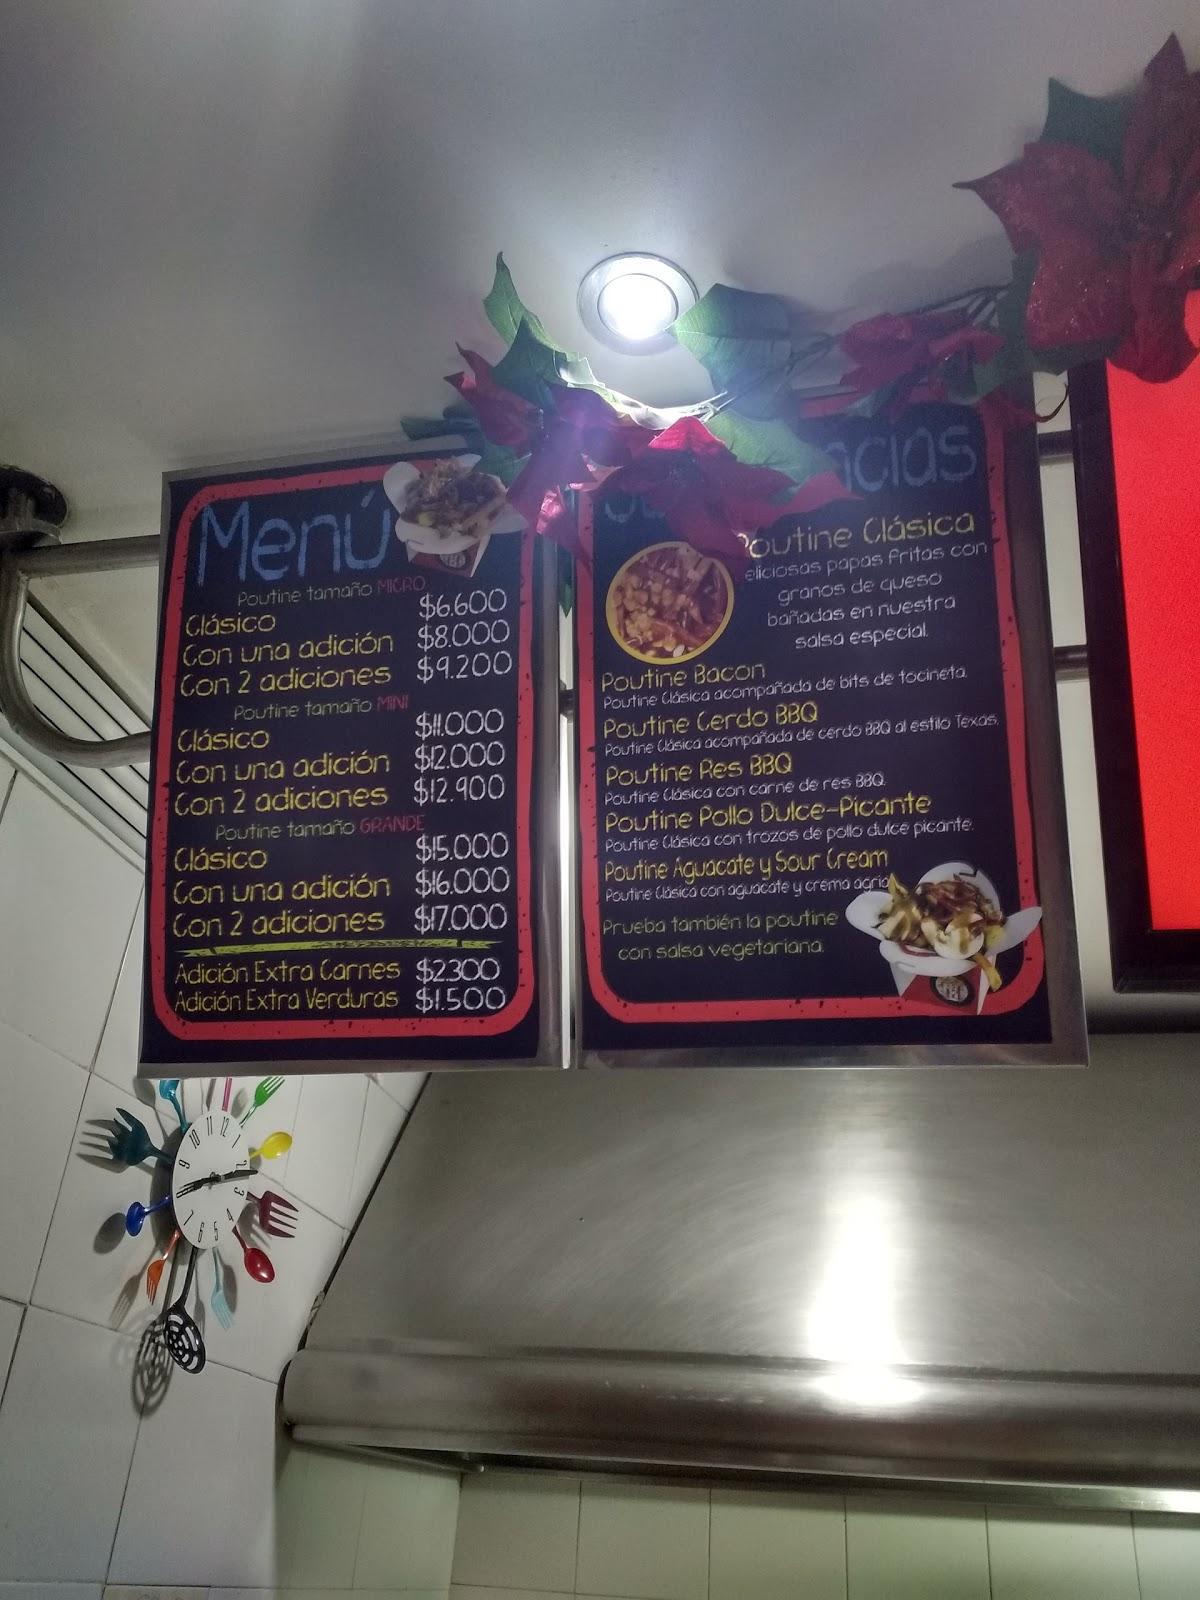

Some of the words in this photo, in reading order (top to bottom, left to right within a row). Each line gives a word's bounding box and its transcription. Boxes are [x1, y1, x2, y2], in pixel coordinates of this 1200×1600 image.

[197, 490, 392, 586] Menú
[863, 512, 975, 544] Clásica
[827, 554, 883, 576] papas
[888, 545, 944, 565] fritas
[951, 541, 987, 557] con
[238, 589, 301, 607] Poutine
[307, 582, 372, 601] tamaño
[377, 577, 426, 594] MICRO
[778, 583, 845, 606] granos
[851, 578, 875, 594] de
[880, 573, 942, 595] queso
[186, 612, 276, 637] Clásico
[419, 589, 507, 621] $6.600
[768, 606, 844, 627] bañadas
[850, 606, 873, 620] en
[878, 595, 956, 615] nuestra
[183, 644, 232, 667] Con
[241, 643, 290, 663] una
[299, 631, 394, 659] adición
[417, 619, 510, 651] $8.000
[795, 631, 844, 649] salsa
[850, 622, 928, 647] especial.
[181, 674, 229, 697] Con
[238, 670, 250, 694] 2
[260, 666, 392, 692] adiciones
[416, 651, 512, 684] $9.200
[601, 669, 687, 692] Poutine
[694, 664, 765, 684] Bacon
[603, 693, 657, 709] Poutine
[661, 690, 710, 705] Clásica
[714, 680, 811, 700] acompañada
[816, 678, 836, 692] de
[840, 673, 869, 689] bits
[873, 672, 894, 686] de
[234, 704, 300, 721] Poutine
[305, 699, 372, 716] tamaño
[376, 696, 409, 712] MINI
[603, 714, 690, 739] Poutine
[697, 706, 768, 732] Cerdo
[776, 701, 818, 726] BBQ
[178, 728, 269, 753] Clásico
[415, 709, 504, 740] $11.000
[605, 742, 654, 757] Poutine
[657, 738, 700, 752] Clásica
[705, 730, 793, 749] acompañada
[796, 728, 814, 742] de
[818, 724, 862, 740] cerdo
[865, 719, 891, 736] BBQ
[895, 720, 907, 733] al
[910, 715, 951, 732] estilo
[176, 761, 226, 785] Con
[234, 759, 284, 781] una
[293, 750, 390, 778] adición
[414, 741, 505, 773] $12.000
[606, 763, 693, 786] Poutine
[700, 759, 743, 780] Res
[750, 752, 792, 776] BBQ
[175, 792, 225, 817] Con
[233, 789, 245, 813] 2
[255, 786, 388, 813] adiciones
[414, 774, 505, 806] $12.900
[604, 790, 659, 805] Poutine
[663, 787, 712, 801] Clásica
[716, 786, 745, 798] con
[749, 782, 795, 796] carne
[799, 777, 818, 792] de
[823, 777, 851, 790] res
[605, 809, 693, 833] Poutine
[700, 804, 753, 827] Pollo
[761, 790, 931, 823] Dulce-Picante
[216, 824, 282, 841] Poutine
[287, 820, 355, 838] tamaño
[360, 815, 425, 832] GRANDE
[605, 837, 659, 852] Poutine
[662, 834, 710, 849] Clásica
[714, 833, 743, 846] con
[746, 829, 798, 843] trozos
[803, 826, 822, 840] de
[827, 823, 863, 843] pollo
[867, 821, 909, 837] dulce
[174, 847, 268, 871] Clásico
[416, 832, 508, 864] $15.000
[605, 859, 668, 881] Poutine
[673, 852, 755, 885] Aguacate
[759, 857, 772, 880] y
[776, 850, 820, 872] Sour
[826, 848, 888, 869] Cream
[173, 881, 223, 905] Con
[233, 879, 282, 902] una
[291, 873, 391, 899] adición
[415, 866, 509, 898] $16.000
[606, 887, 652, 902] Poutine
[655, 885, 697, 899] Clásica
[700, 885, 725, 897] con
[728, 880, 790, 900] aguacate
[793, 883, 802, 897] y
[805, 878, 850, 892] crema
[173, 913, 222, 938] Con
[231, 911, 242, 936] 2
[252, 909, 385, 936] adiciones
[414, 903, 507, 935] $17.000
[603, 918, 666, 935] Prueba
[671, 913, 741, 932] también
[746, 913, 761, 929] la
[766, 910, 839, 933] poutine
[618, 948, 651, 960] con
[656, 943, 703, 958] salsa
[708, 938, 824, 961] vegetariana.
[175, 962, 248, 984] Adición
[255, 959, 313, 984] Extra
[320, 958, 400, 980] Carnes
[175, 990, 240, 1013] Adición
[247, 988, 300, 1011] Extra
[305, 987, 399, 1010] Verduras
[416, 986, 505, 1013] $1.500
[189, 1129, 201, 1149] 10
[206, 1116, 213, 1136] 11
[220, 1116, 230, 1138] 12
[233, 1186, 245, 1196] 3
[213, 1221, 219, 1241] 5
[226, 1208, 234, 1222] 4
